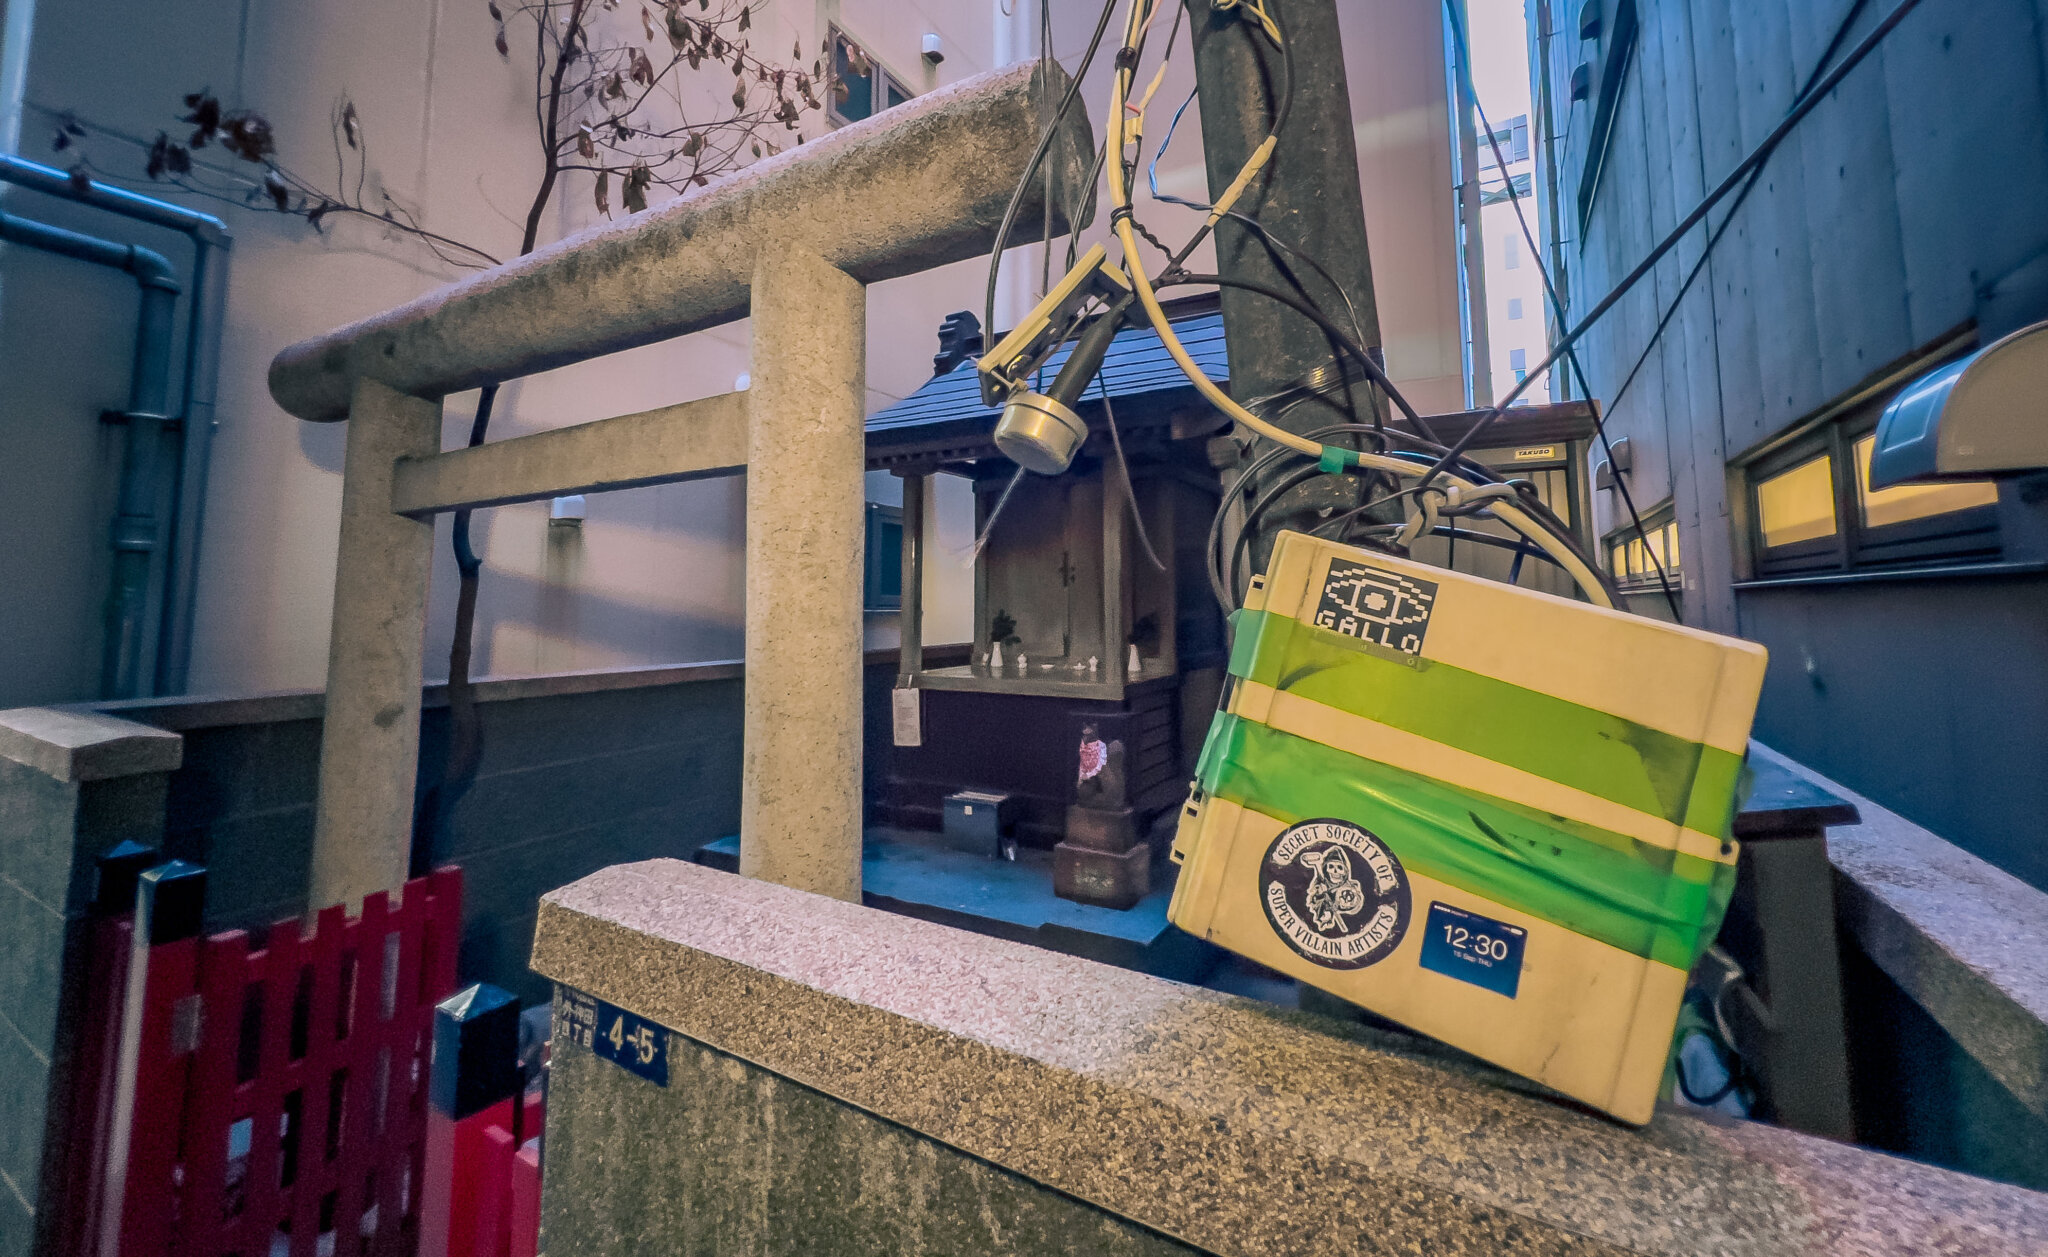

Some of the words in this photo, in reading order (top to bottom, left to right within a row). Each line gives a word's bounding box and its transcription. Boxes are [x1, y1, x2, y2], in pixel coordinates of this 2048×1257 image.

[1316, 609, 1421, 654] GALLO
[1277, 825, 1319, 861] SECRET
[1326, 825, 1380, 861] SOCIETY
[1376, 864, 1394, 882] OF
[1270, 888, 1296, 929] SUPER
[1294, 926, 1343, 957] VILLAIN
[1348, 911, 1394, 956] ARTISTS
[1443, 924, 1508, 961] 12:30
[609, 1014, 655, 1065] 4-5
